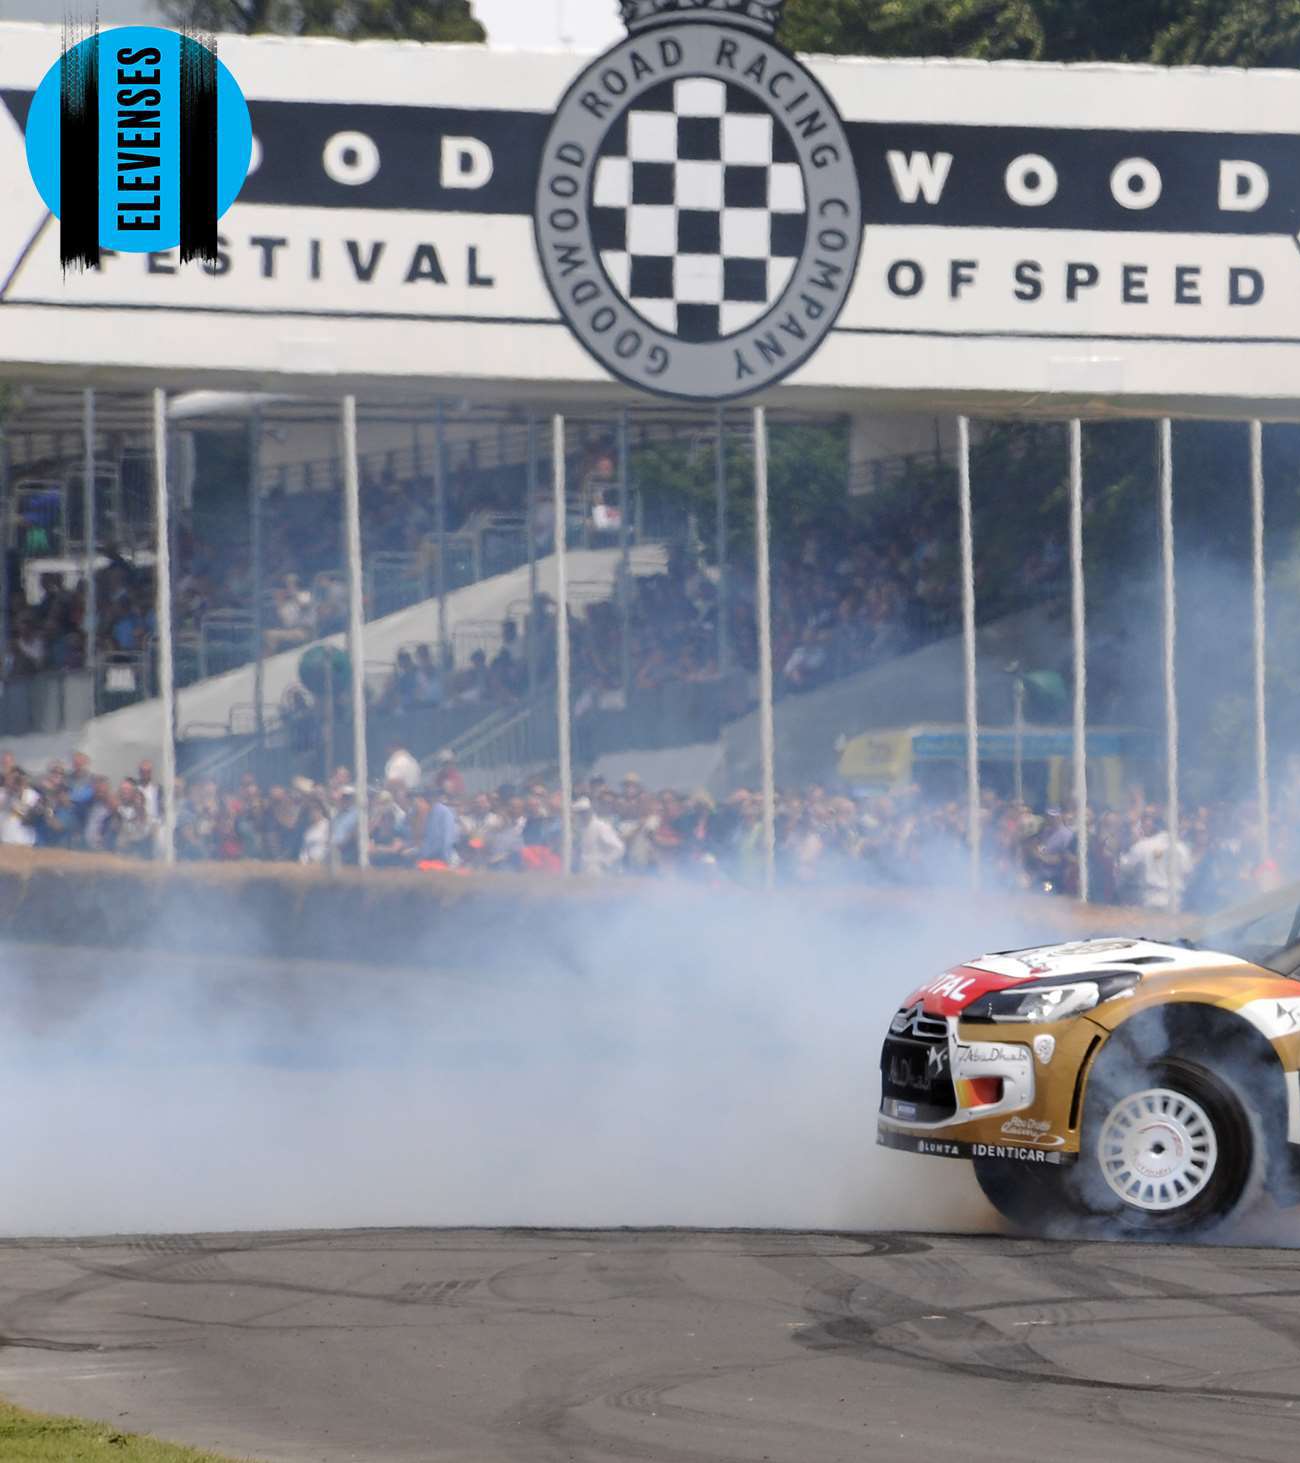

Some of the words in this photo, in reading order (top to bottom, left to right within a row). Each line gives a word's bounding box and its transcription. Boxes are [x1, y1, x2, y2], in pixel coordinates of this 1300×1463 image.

[581, 39, 683, 119] ROAD
[716, 38, 839, 170] RACING
[886, 150, 1270, 213] WOOD
[550, 142, 670, 375] GOODWOOD
[733, 198, 849, 380] COMPANY
[887, 259, 979, 299] OF
[1013, 260, 1265, 306] SPEED
[973, 1143, 1045, 1162] IDENTICAR
